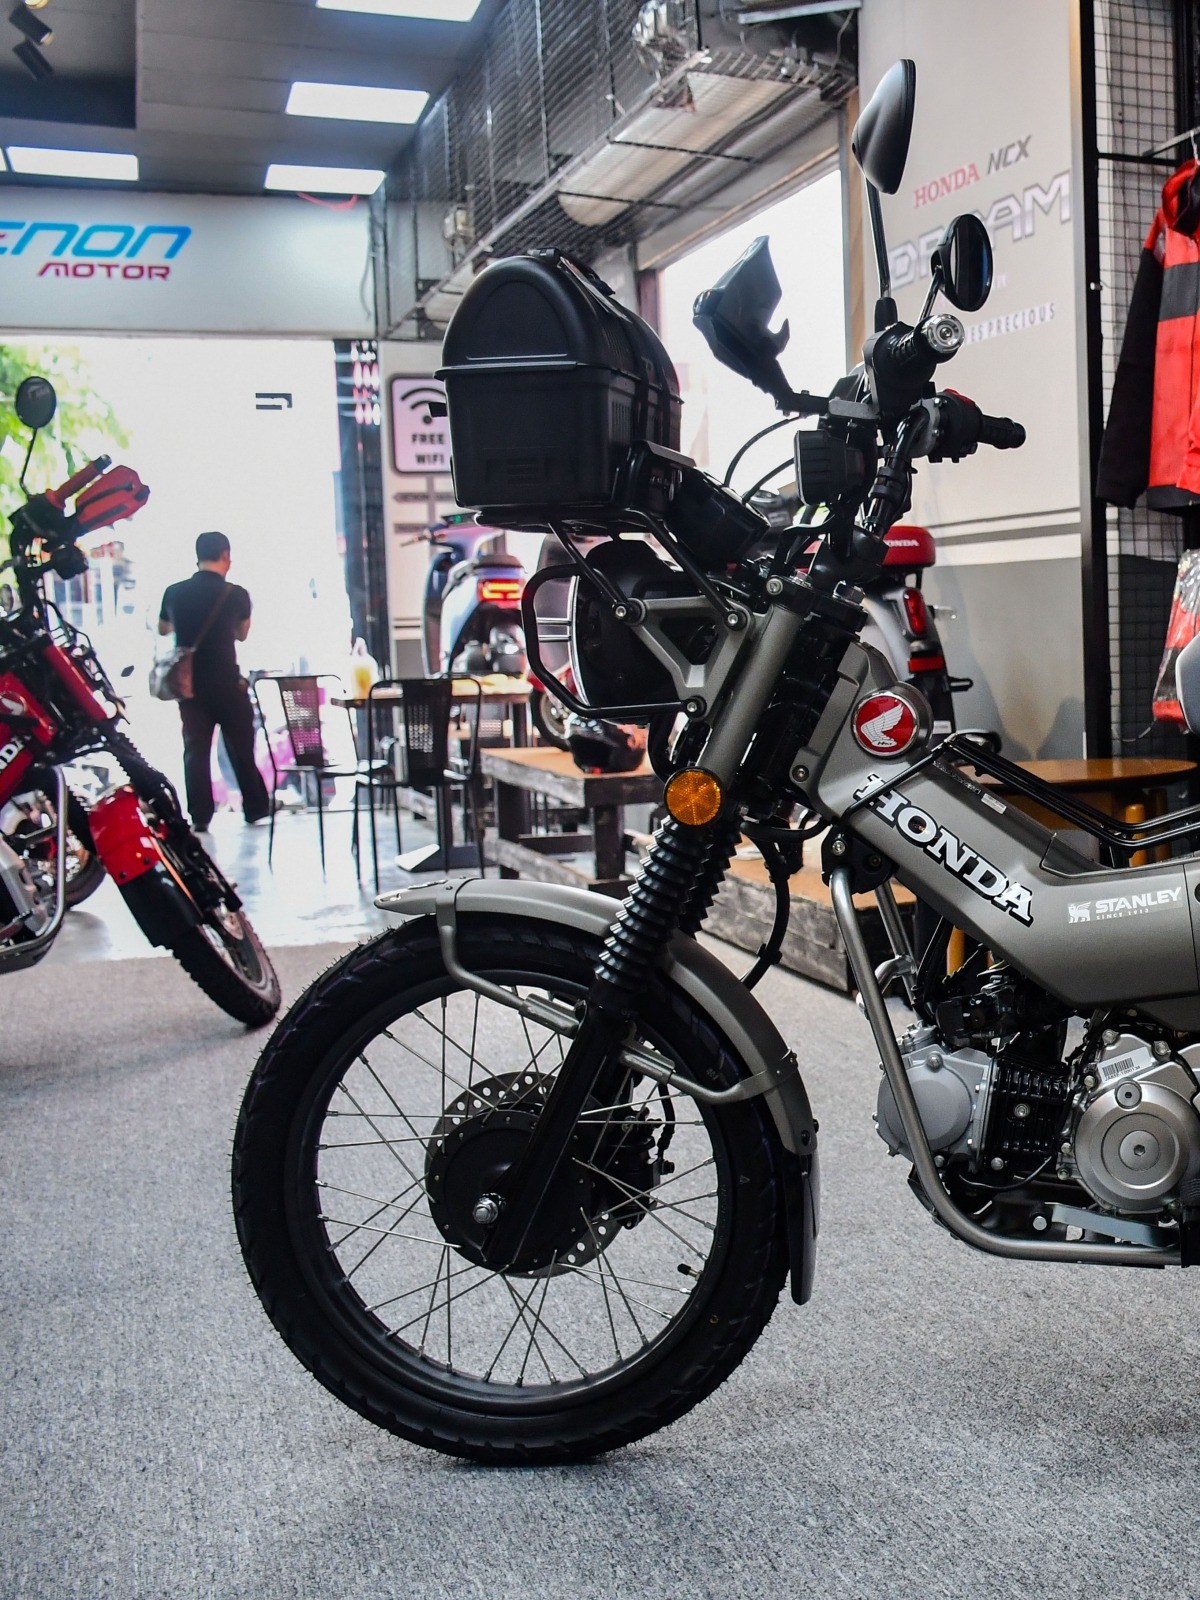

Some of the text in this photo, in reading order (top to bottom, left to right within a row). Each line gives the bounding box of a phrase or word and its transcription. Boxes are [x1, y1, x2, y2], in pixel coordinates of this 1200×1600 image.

[913, 135, 1032, 208] HONDA NCX
[889, 170, 1071, 291] DRAM
[38, 262, 170, 281] MOTOR
[987, 303, 1055, 335] PRECIOUS
[411, 433, 445, 445] FREE
[853, 773, 1034, 928] HONDA
[1095, 887, 1182, 914] STANLEY
[1096, 912, 1123, 920] SINCE
